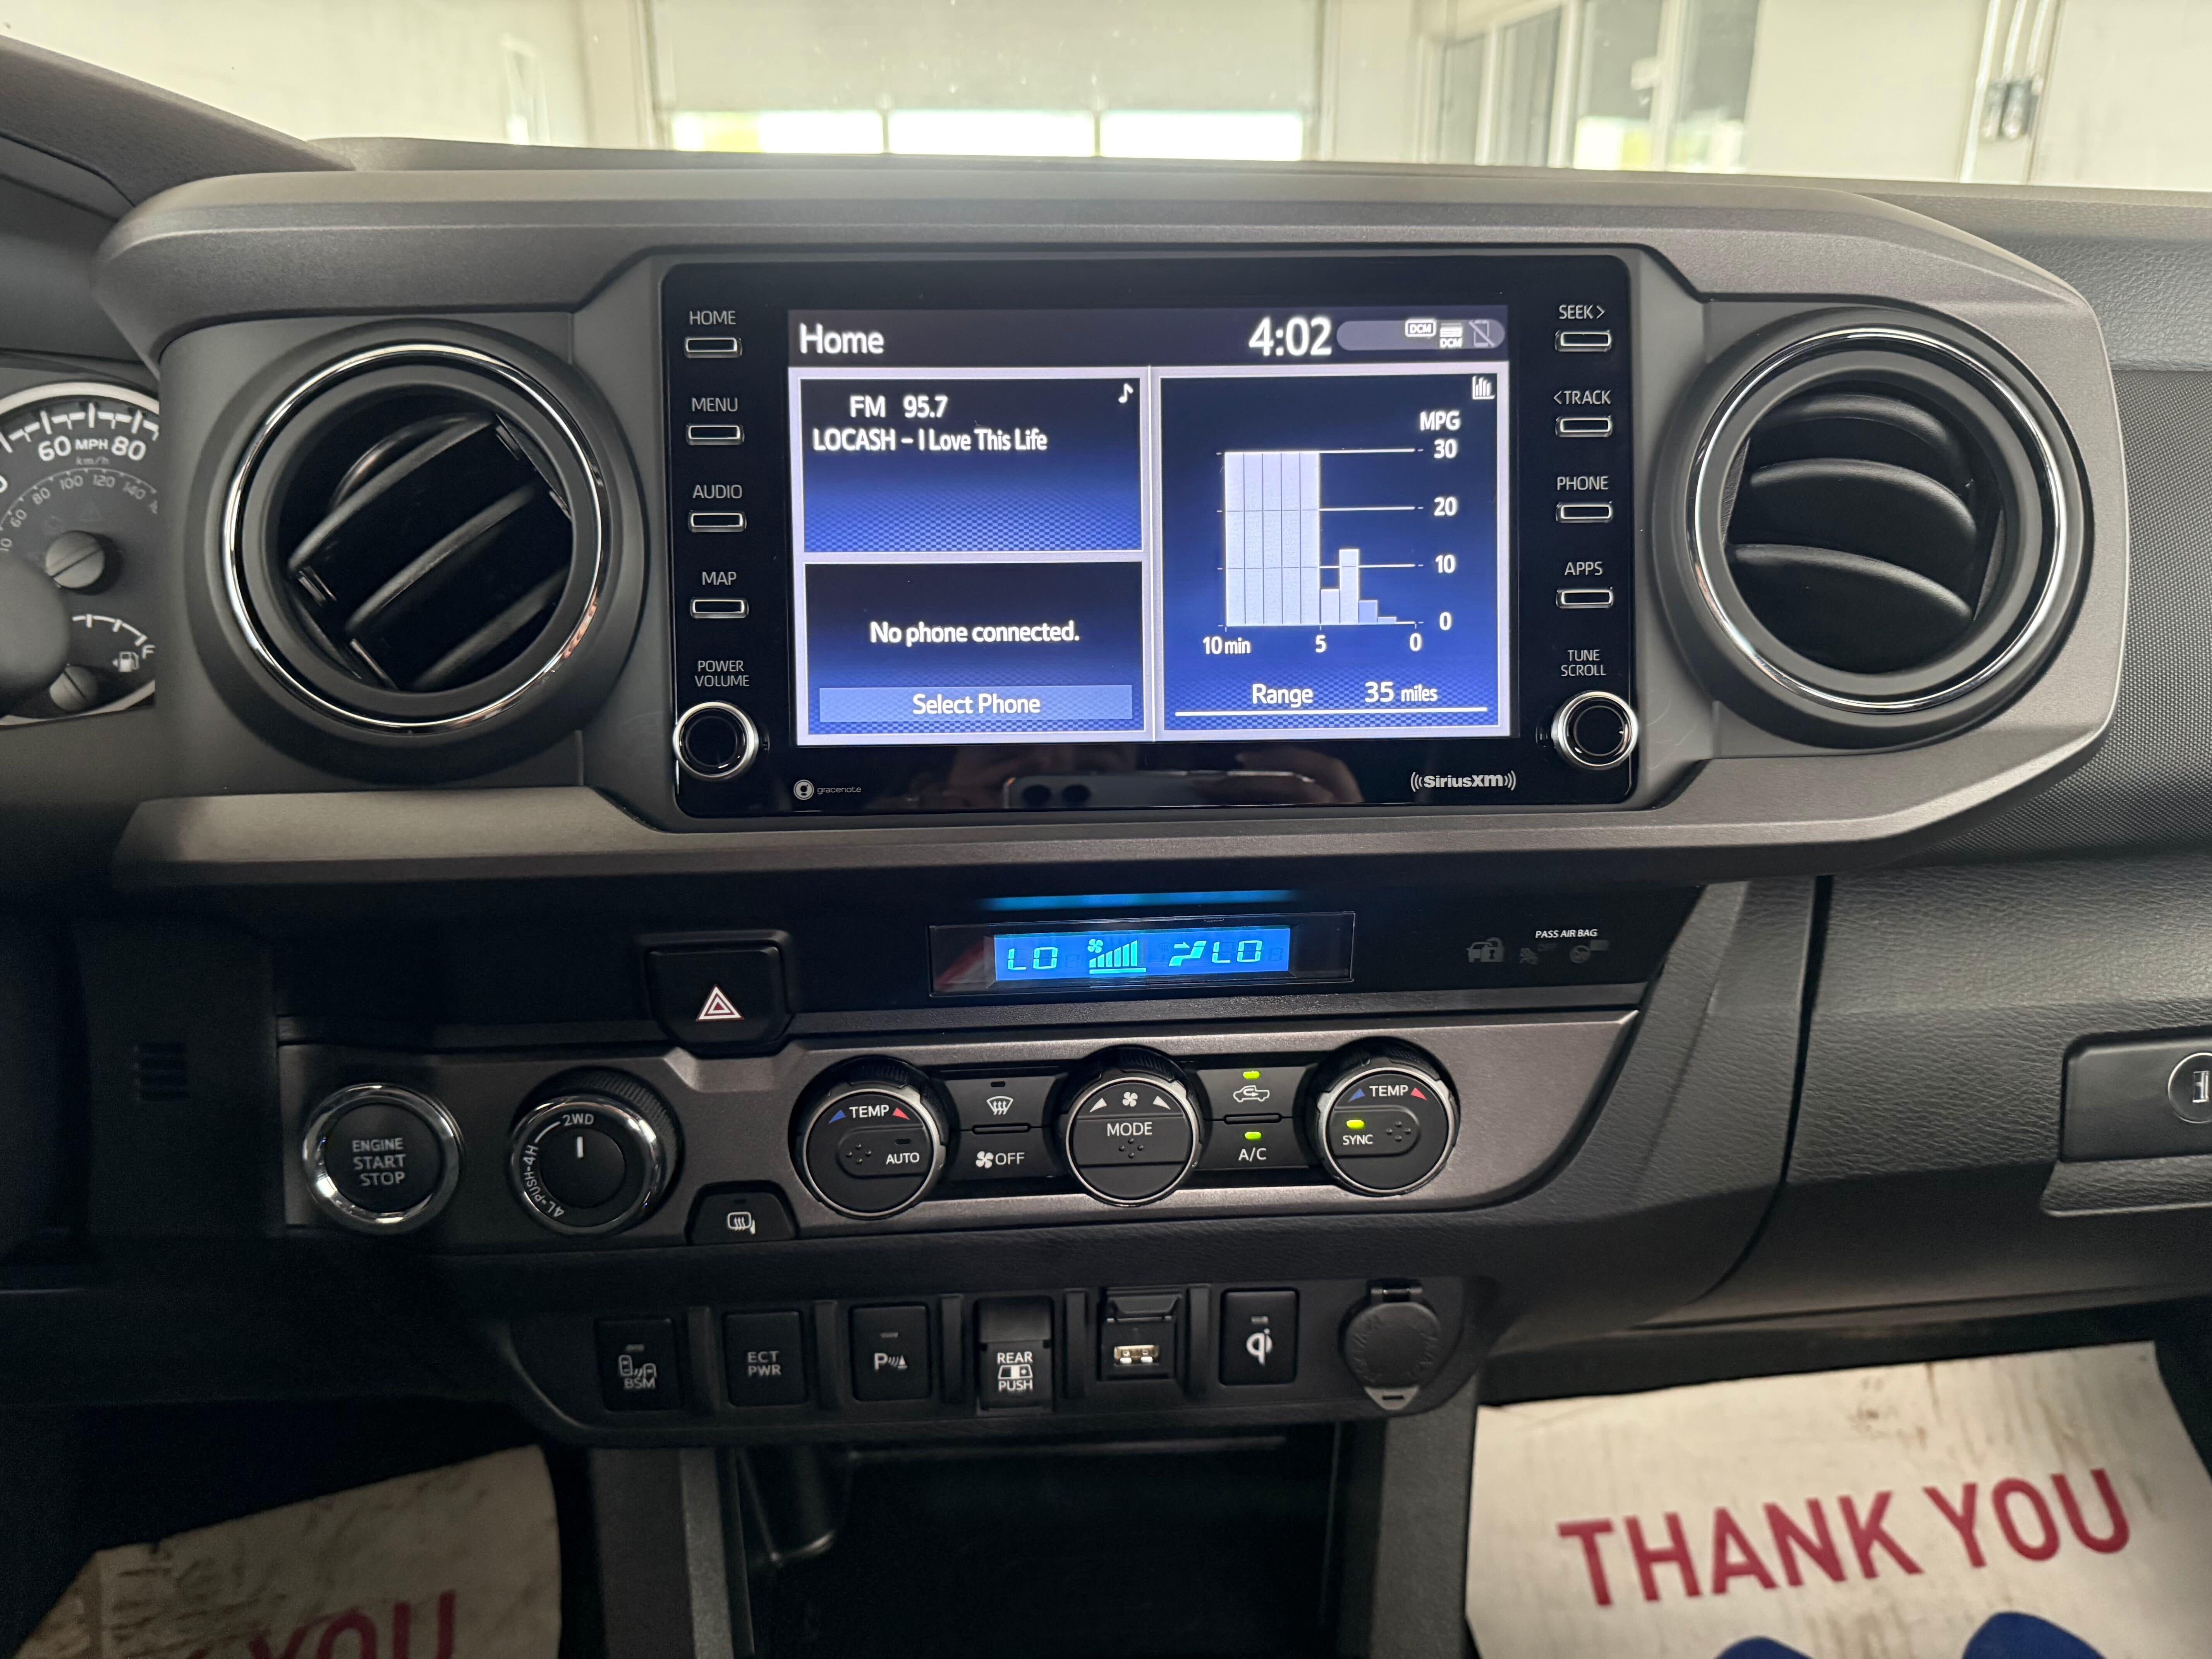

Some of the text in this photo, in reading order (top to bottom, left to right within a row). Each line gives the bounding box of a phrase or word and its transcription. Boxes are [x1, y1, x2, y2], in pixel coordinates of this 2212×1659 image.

[690, 311, 736, 325] HOME
[1249, 316, 1332, 356] 4:02
[1410, 324, 1431, 333] DCM
[800, 323, 884, 354] Home
[1440, 337, 1462, 348] DCM
[692, 398, 738, 412] MENU
[850, 395, 948, 418] FM 95.7
[1420, 410, 1460, 431] MPG
[75, 438, 108, 450] MPH
[813, 428, 896, 451] LOCASH
[919, 429, 924, 451] I
[929, 428, 971, 451] Love
[974, 428, 1011, 451] This
[1015, 428, 1048, 451] Life
[38, 436, 71, 461] 60
[112, 436, 146, 460] 80
[1434, 439, 1457, 459] 30
[59, 475, 83, 490] 100
[93, 475, 115, 488] 120
[1557, 476, 1609, 490] PHONE
[31, 488, 51, 505] 80
[122, 481, 146, 500] 140
[692, 484, 742, 498] AUDIO
[1434, 497, 1457, 517] 20
[10, 509, 27, 527] 60
[0, 538, 12, 551] 0
[1435, 555, 1456, 574] 10
[1565, 561, 1603, 575] APPS
[702, 572, 737, 585] MAP
[1439, 613, 1452, 630] 0
[870, 620, 1080, 647] No phone connected.
[1202, 636, 1251, 655] 10 min
[1315, 635, 1326, 653] 5
[1409, 633, 1422, 652] 0
[142, 644, 156, 659] F
[1567, 650, 1600, 661] TUNE
[698, 660, 744, 672] POWER
[1561, 665, 1606, 677] SCROLL
[695, 675, 749, 687] VOLUME
[1252, 682, 1437, 708] Range 35 miles
[912, 693, 1040, 715] Select Phone
[1535, 930, 1559, 938] PASS
[1008, 947, 1058, 970] LO
[1212, 939, 1263, 963] LO
[1369, 1085, 1408, 1097] TEMP
[849, 1104, 889, 1118] TEMP
[563, 1113, 594, 1127] 2WD
[1107, 1122, 1152, 1137] MODE
[352, 1137, 404, 1153] ENGINE
[1342, 1134, 1374, 1146] SYNC
[354, 1154, 406, 1170] START
[886, 1152, 920, 1164] AUTO
[995, 1152, 1025, 1165] OFF
[1238, 1148, 1266, 1162] A/C
[360, 1171, 405, 1187] STOP
[747, 1351, 779, 1363] ECT
[997, 1352, 1033, 1364] REAR
[748, 1364, 781, 1377] PWR
[624, 1378, 656, 1389] BSM
[998, 1379, 1033, 1391] PUSH
[1557, 1468, 2130, 1607] THANK YOU
